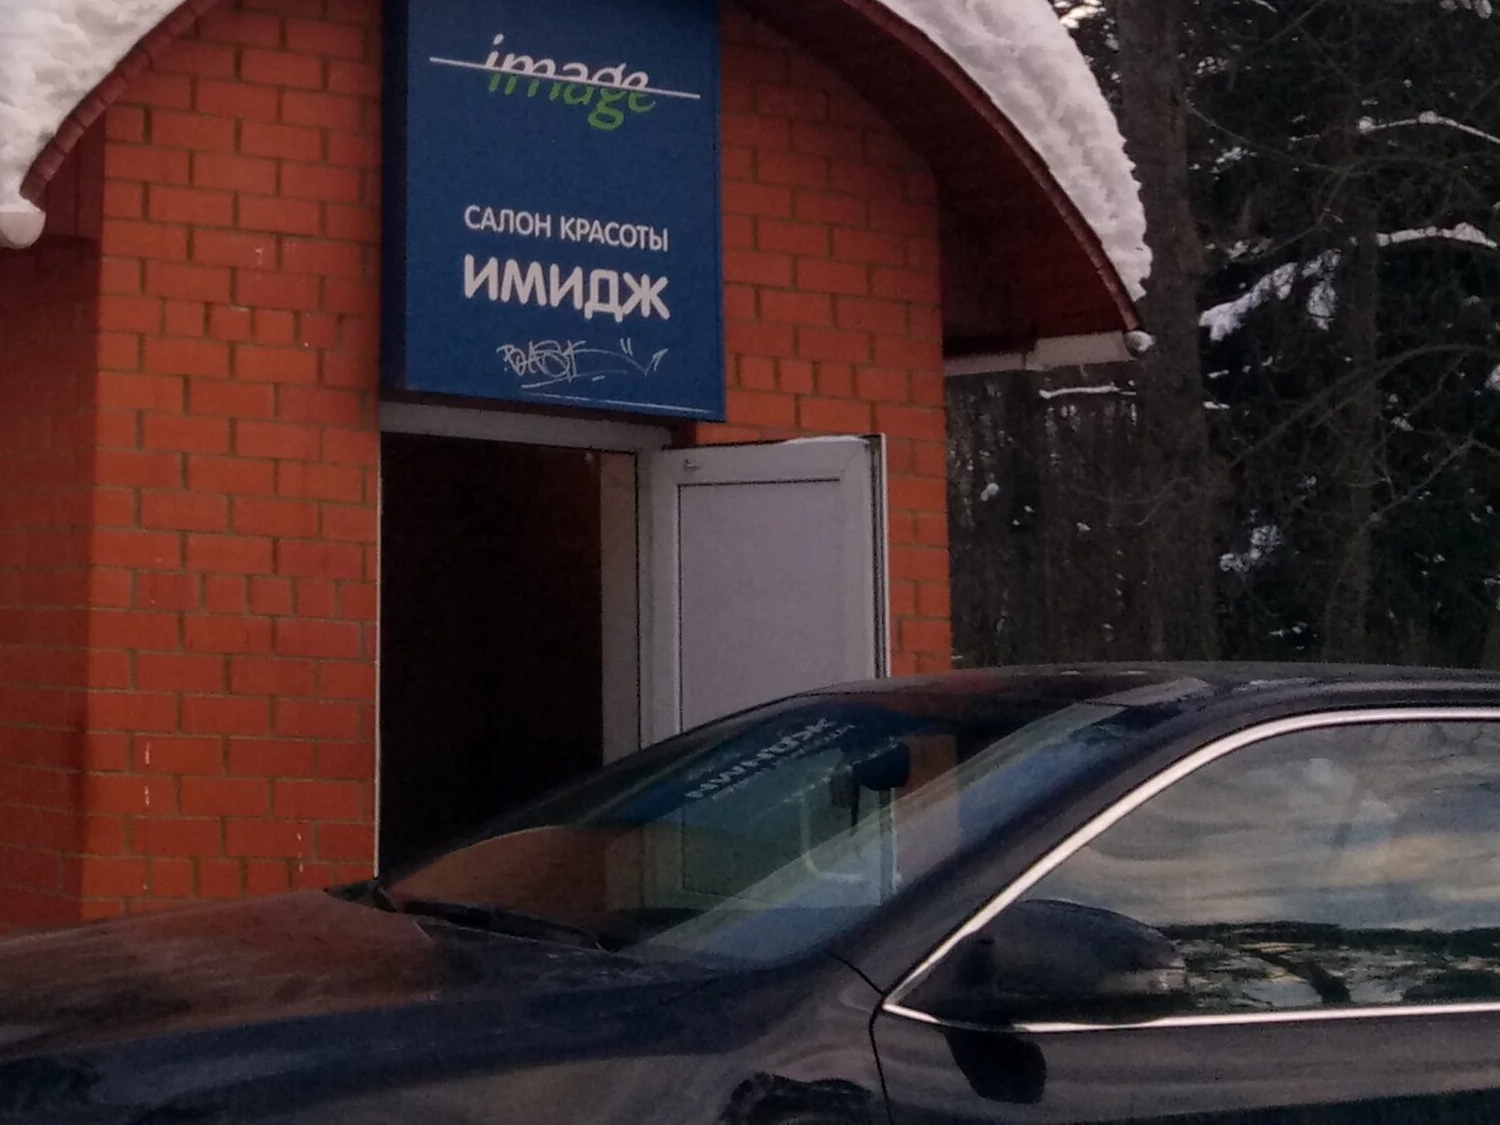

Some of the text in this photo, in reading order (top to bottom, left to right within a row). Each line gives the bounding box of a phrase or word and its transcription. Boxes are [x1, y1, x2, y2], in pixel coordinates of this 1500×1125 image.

[484, 33, 657, 131] image
[463, 204, 669, 252] САЛОН КРАСОТЫ
[463, 253, 671, 323] ИМИДЖ
